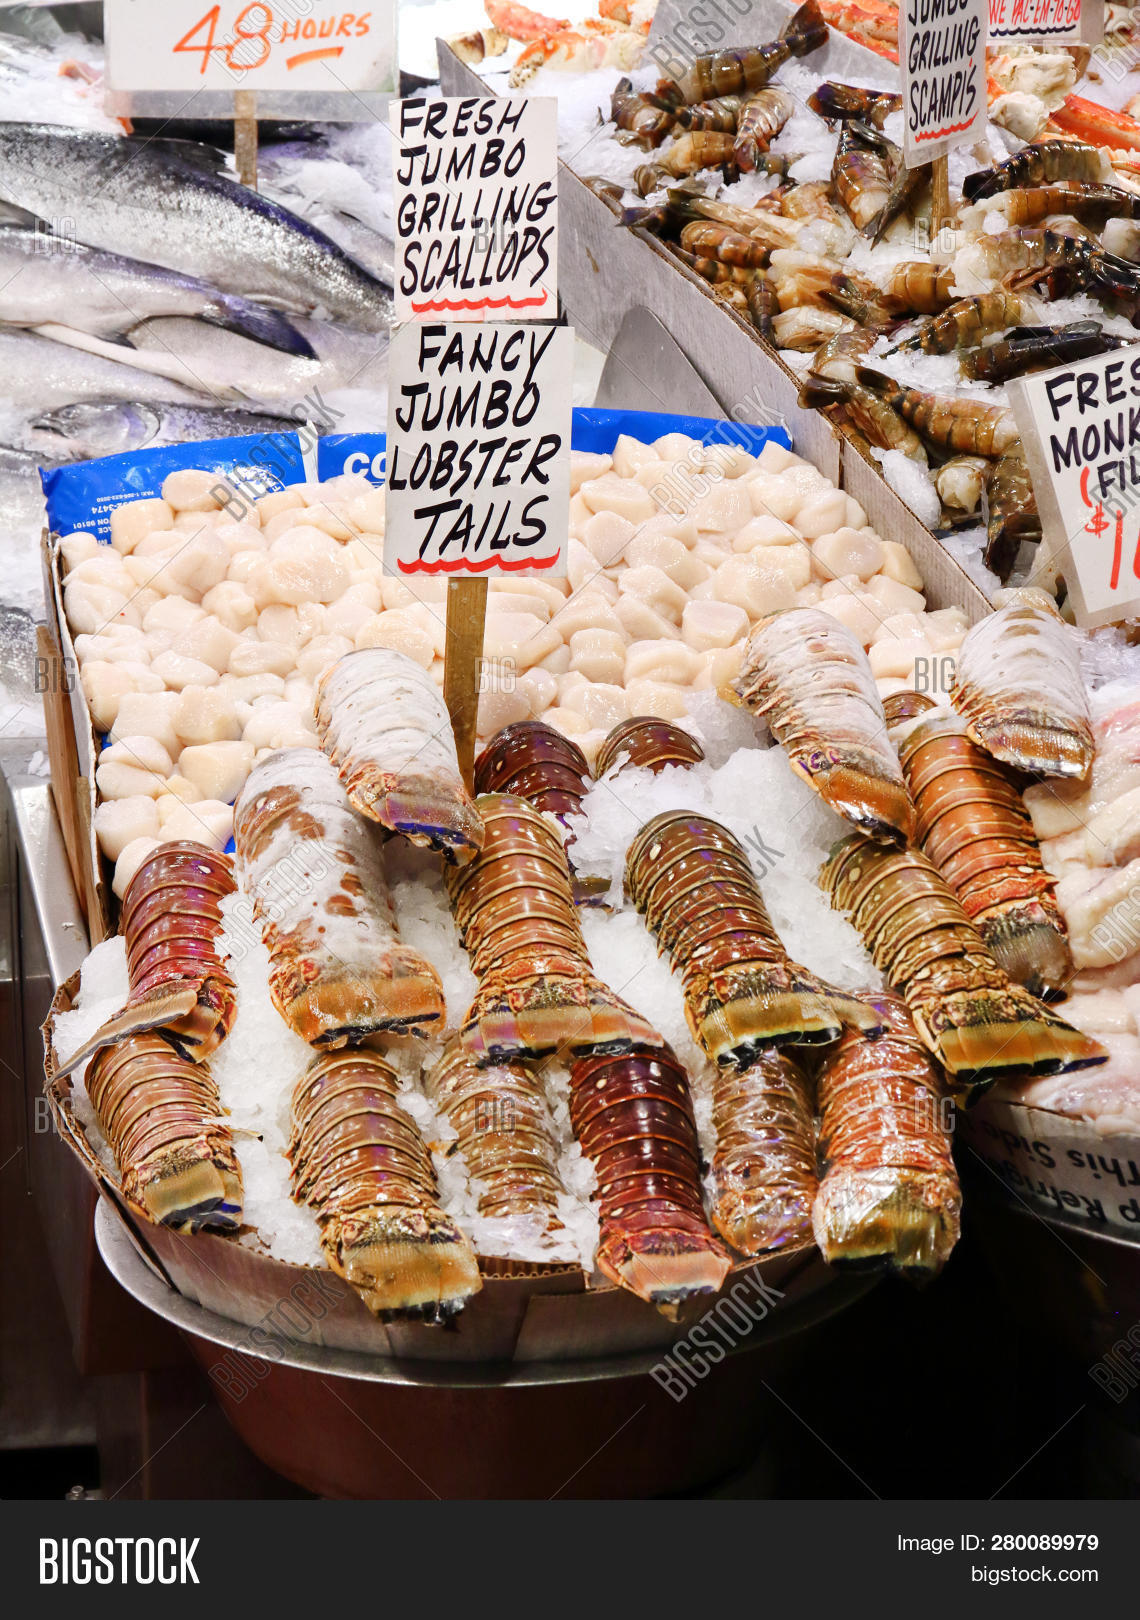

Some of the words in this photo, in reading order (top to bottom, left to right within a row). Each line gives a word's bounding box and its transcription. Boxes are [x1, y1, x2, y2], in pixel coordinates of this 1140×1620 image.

[280, 12, 372, 43] HOURS
[909, 16, 980, 74] GRILLING
[400, 97, 528, 140] FRESH
[397, 138, 525, 187] JUMBO
[398, 181, 558, 237] GRILLING
[400, 226, 555, 296] SCALLOPS
[418, 326, 557, 391] FANCY
[396, 380, 540, 433] JUMBO
[389, 434, 562, 497] LOBSTER
[414, 495, 549, 559] TAILS
